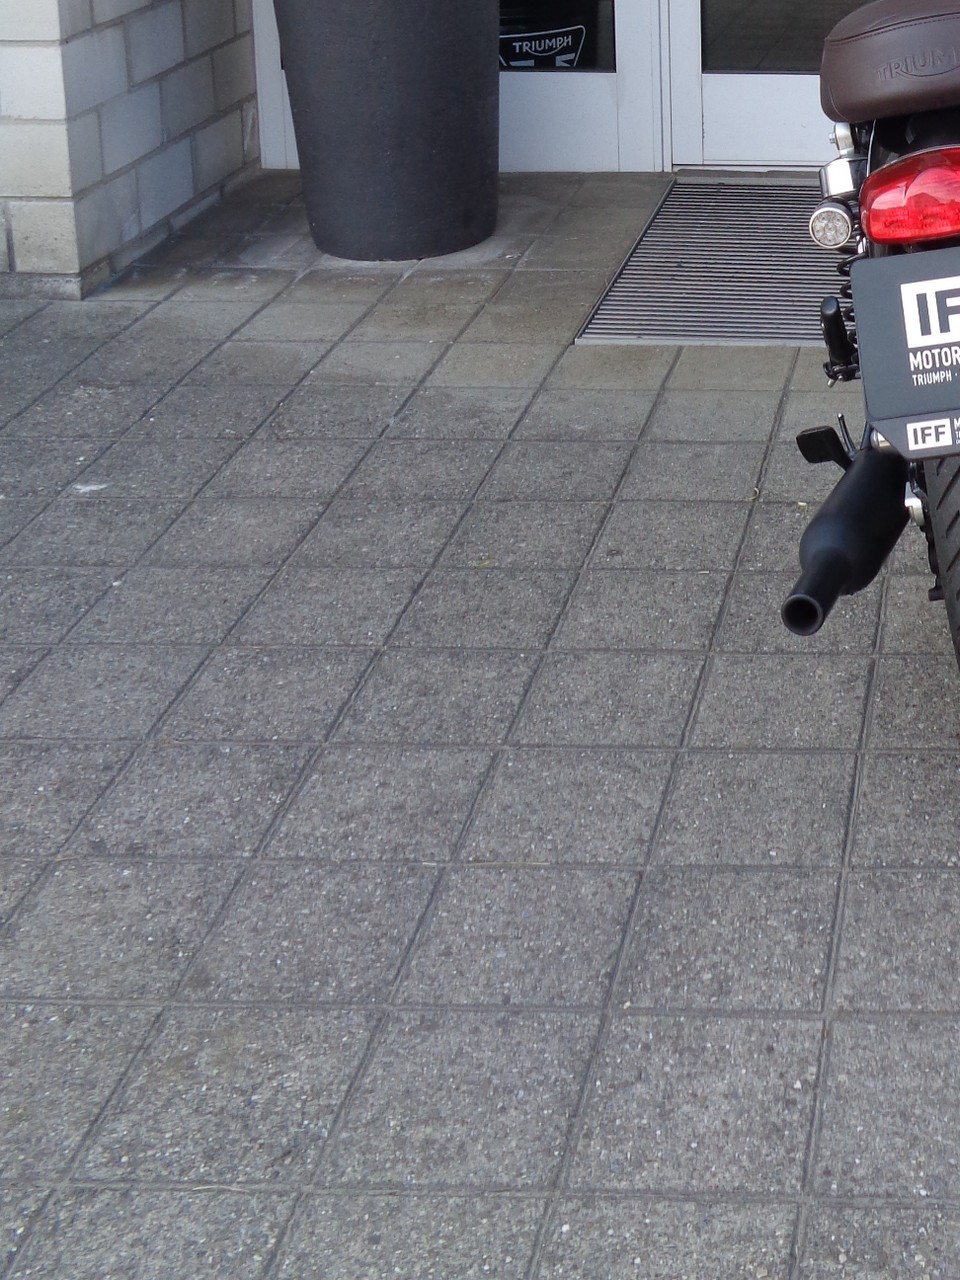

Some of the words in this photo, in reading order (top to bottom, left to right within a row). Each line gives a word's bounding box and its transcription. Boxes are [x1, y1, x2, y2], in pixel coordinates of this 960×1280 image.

[512, 35, 572, 56] TRIUMPH
[912, 369, 953, 386] TRIUMPH
[912, 424, 946, 445] IFF
